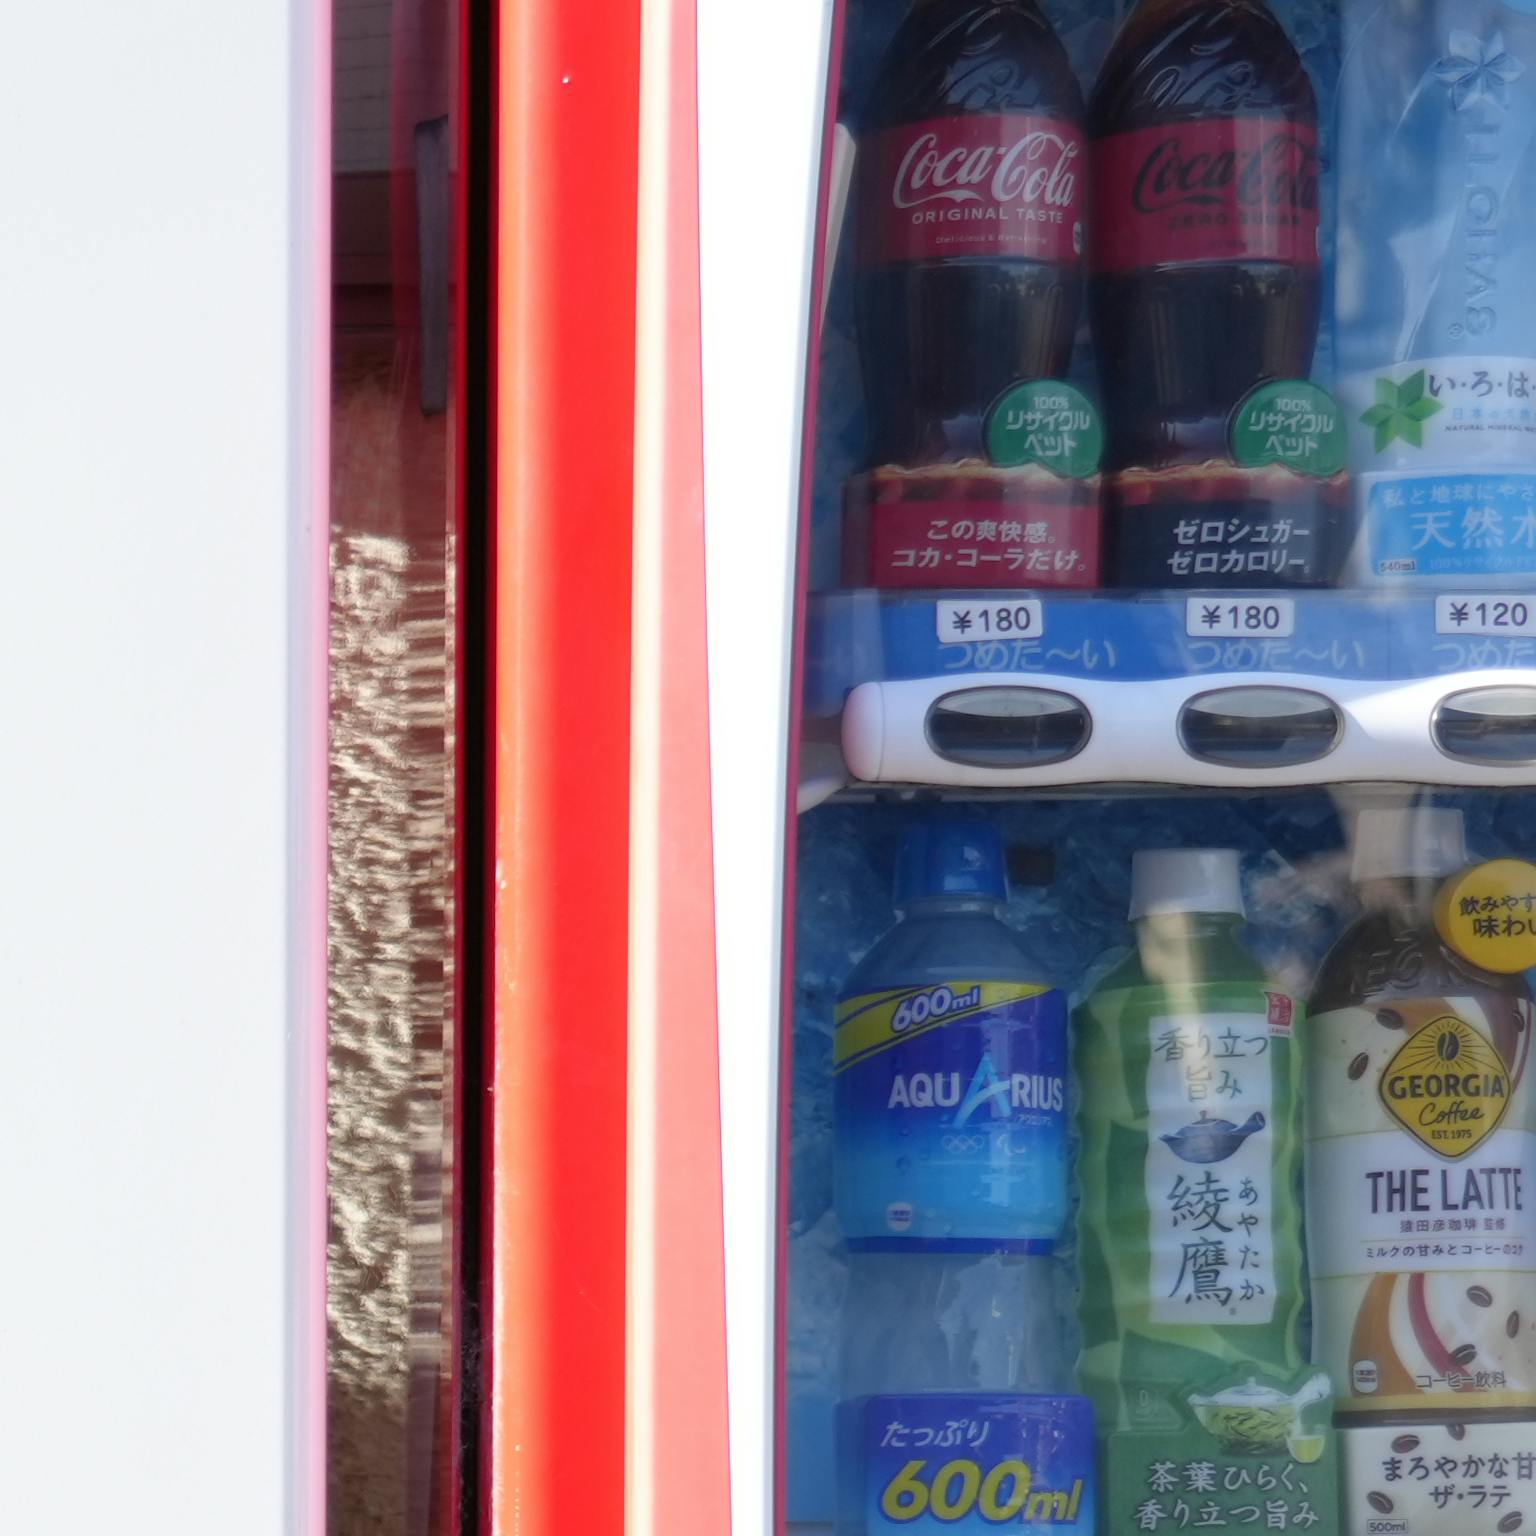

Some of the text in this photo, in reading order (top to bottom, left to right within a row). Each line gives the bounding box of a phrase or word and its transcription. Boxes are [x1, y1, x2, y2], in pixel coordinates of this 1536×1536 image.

[892, 131, 1080, 209] Coca-Cola
[911, 206, 1064, 226] ORIGINAL TASTE
[1006, 410, 1091, 432] リサイクル
[926, 518, 1058, 545] この爽快感。
[1173, 519, 1311, 546] ゼロシュガー
[890, 547, 1088, 573] コカ・コーラだけ。
[951, 607, 1032, 634] ¥180
[1201, 605, 1281, 632] ¥180
[1449, 602, 1529, 627] ¥120
[891, 986, 982, 1033] 600ml
[1154, 1026, 1271, 1061] 香り立つ
[887, 1054, 1065, 1128] AQUARIUS
[1388, 1073, 1504, 1099] GEORGIA
[1418, 1100, 1486, 1128] Coffee
[1365, 1165, 1524, 1214] THE LATTE
[1167, 1170, 1239, 1309] 綾鷹
[880, 1418, 992, 1450] たっぷり
[878, 1458, 1086, 1526] 600ml
[1133, 1498, 1321, 1532] 香り立つ旨み
